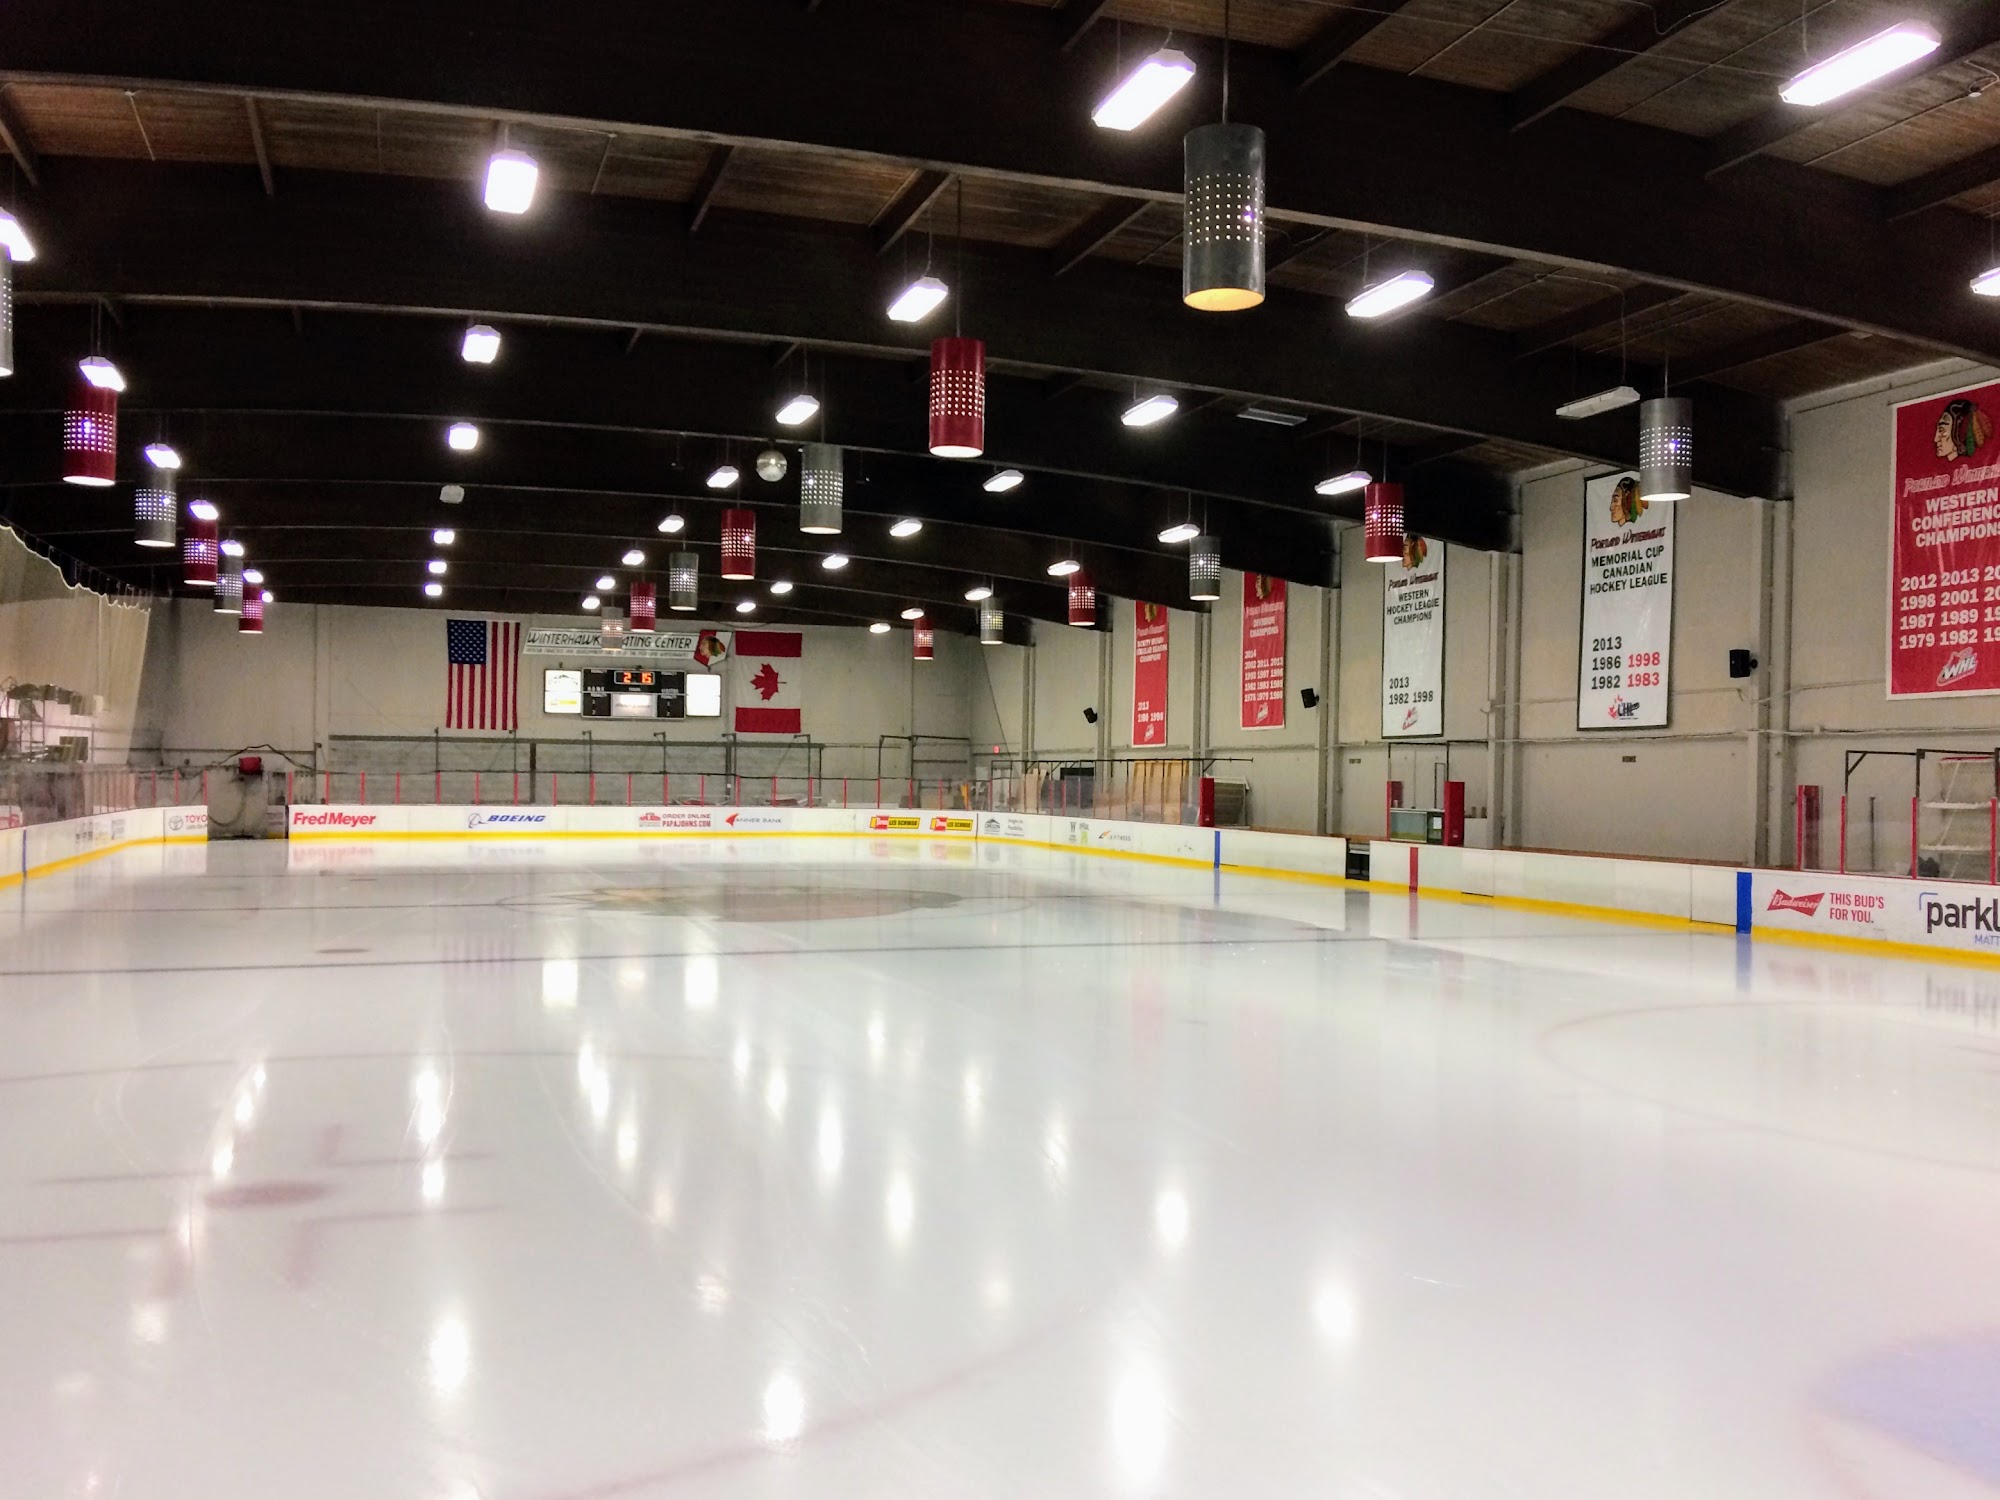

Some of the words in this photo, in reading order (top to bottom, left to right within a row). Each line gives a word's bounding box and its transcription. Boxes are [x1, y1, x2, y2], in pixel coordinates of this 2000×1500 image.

[1926, 487, 1998, 513] WESTERN
[1912, 504, 2000, 532] CONFERENC
[1592, 550, 1642, 568] MEMORIAL
[1646, 545, 1664, 558] CUP
[1603, 562, 1652, 579] CANADIAN
[1901, 574, 1937, 591] 2012
[1941, 568, 1980, 586] 2013
[1984, 566, 2000, 581] 20
[1590, 580, 1627, 594] HOCKEY
[1630, 573, 1667, 588] LEAGUE
[1399, 589, 1429, 602] WESTERN
[1900, 594, 1936, 611] 1998
[1940, 588, 1979, 606] 2001
[1984, 586, 2000, 602] 20
[1387, 603, 1412, 615] HOCKEY
[1415, 598, 1439, 610] LEAGUE
[1394, 611, 1432, 625] CHAMPIONS
[1900, 613, 1935, 630] 1987
[1941, 609, 1978, 626] 1989
[527, 632, 600, 646] WINTERHAWK
[622, 635, 650, 648] ATING
[654, 636, 692, 648] CENTER
[1592, 636, 1622, 652] 2013
[1900, 632, 1935, 650] 1979
[1940, 629, 1978, 646] 1982
[1592, 656, 1621, 671] 1986
[1628, 652, 1660, 668] 1998
[1389, 676, 1410, 689] 2013
[1592, 675, 1620, 690] 1982
[1628, 672, 1660, 688] 1983
[1389, 693, 1409, 704] 1982
[1413, 690, 1434, 703] 1998
[185, 814, 208, 822] TOYO
[1772, 894, 1818, 908] Budweiser
[1830, 893, 1851, 906] THIS
[1854, 895, 1884, 909] BUD'S
[1830, 908, 1848, 920] FOR
